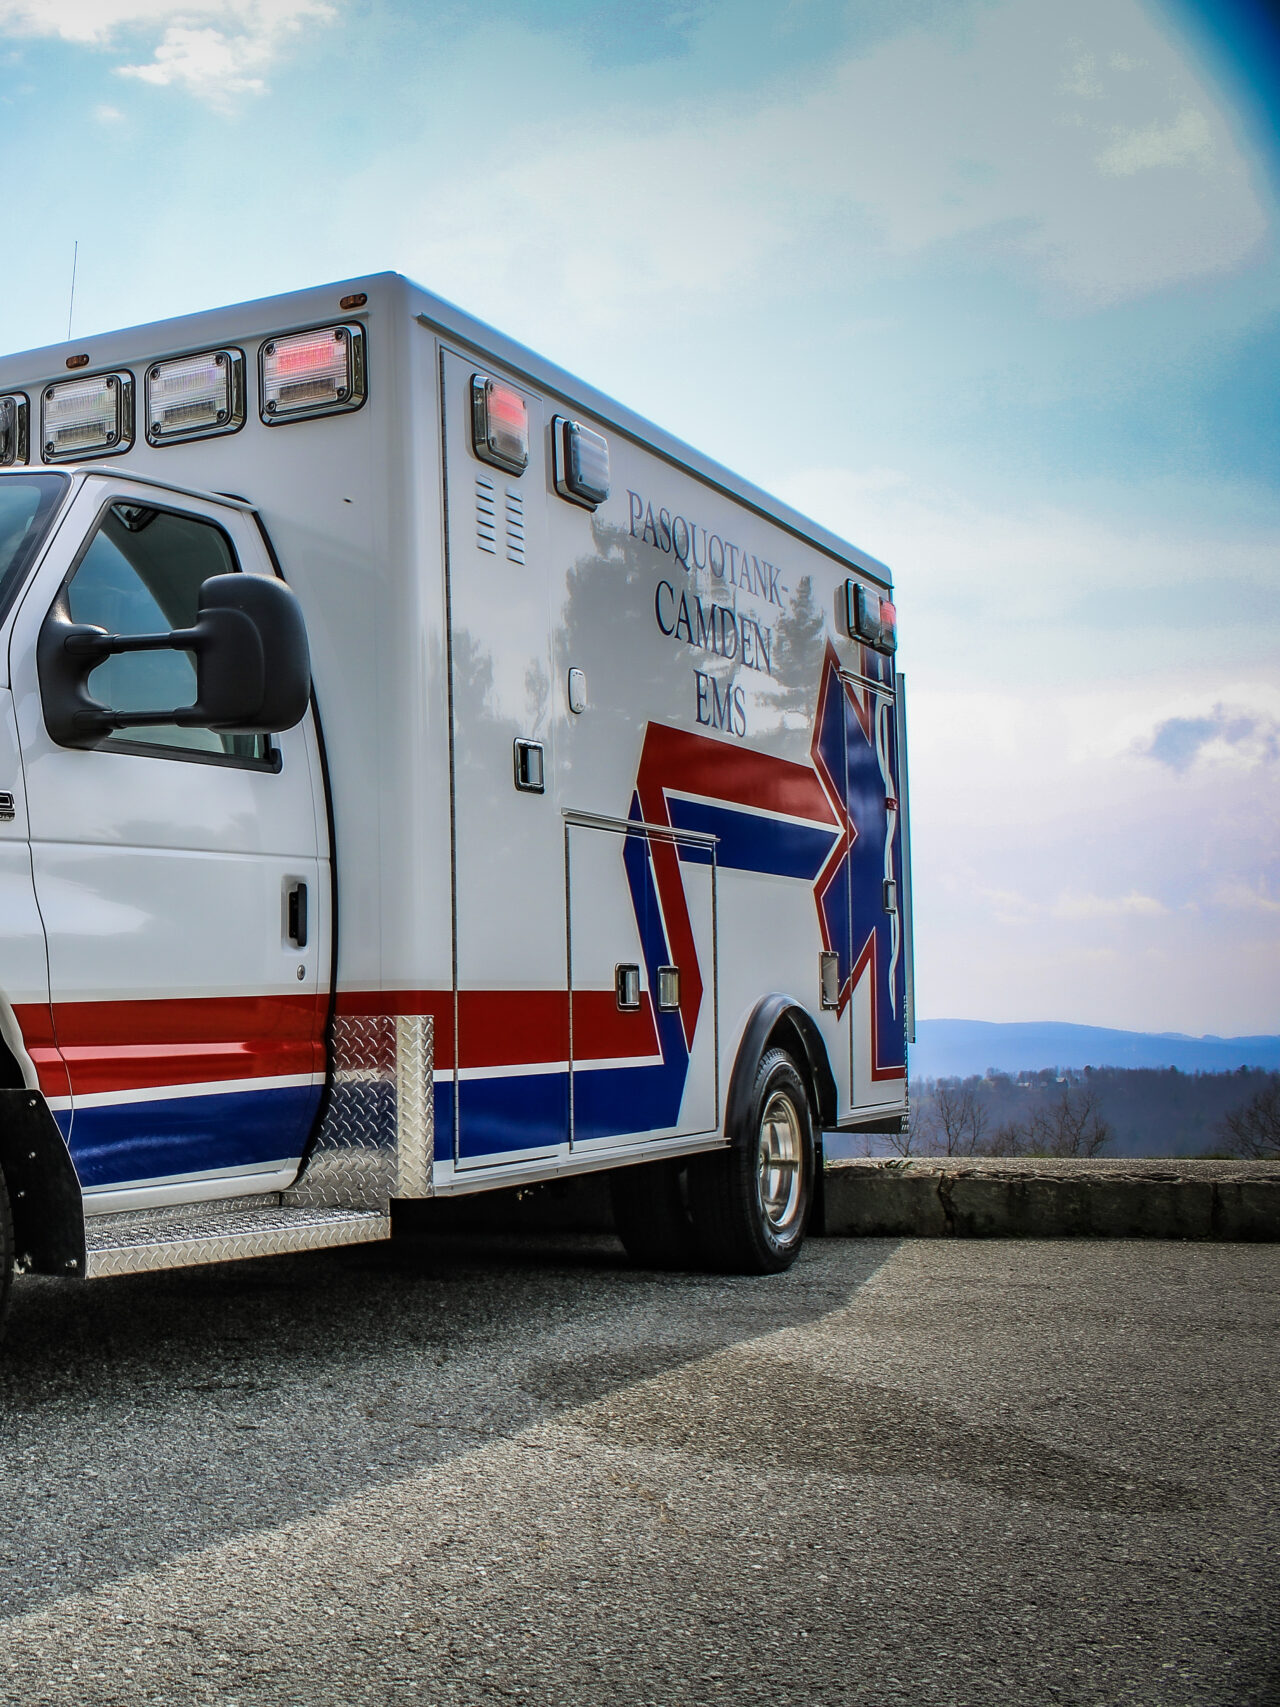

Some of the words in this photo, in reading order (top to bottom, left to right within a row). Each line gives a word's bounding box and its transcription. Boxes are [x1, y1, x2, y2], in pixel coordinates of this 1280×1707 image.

[626, 488, 789, 608] PASQUOTANK-
[654, 580, 771, 674] CAMDEN
[693, 668, 747, 738] EMS
